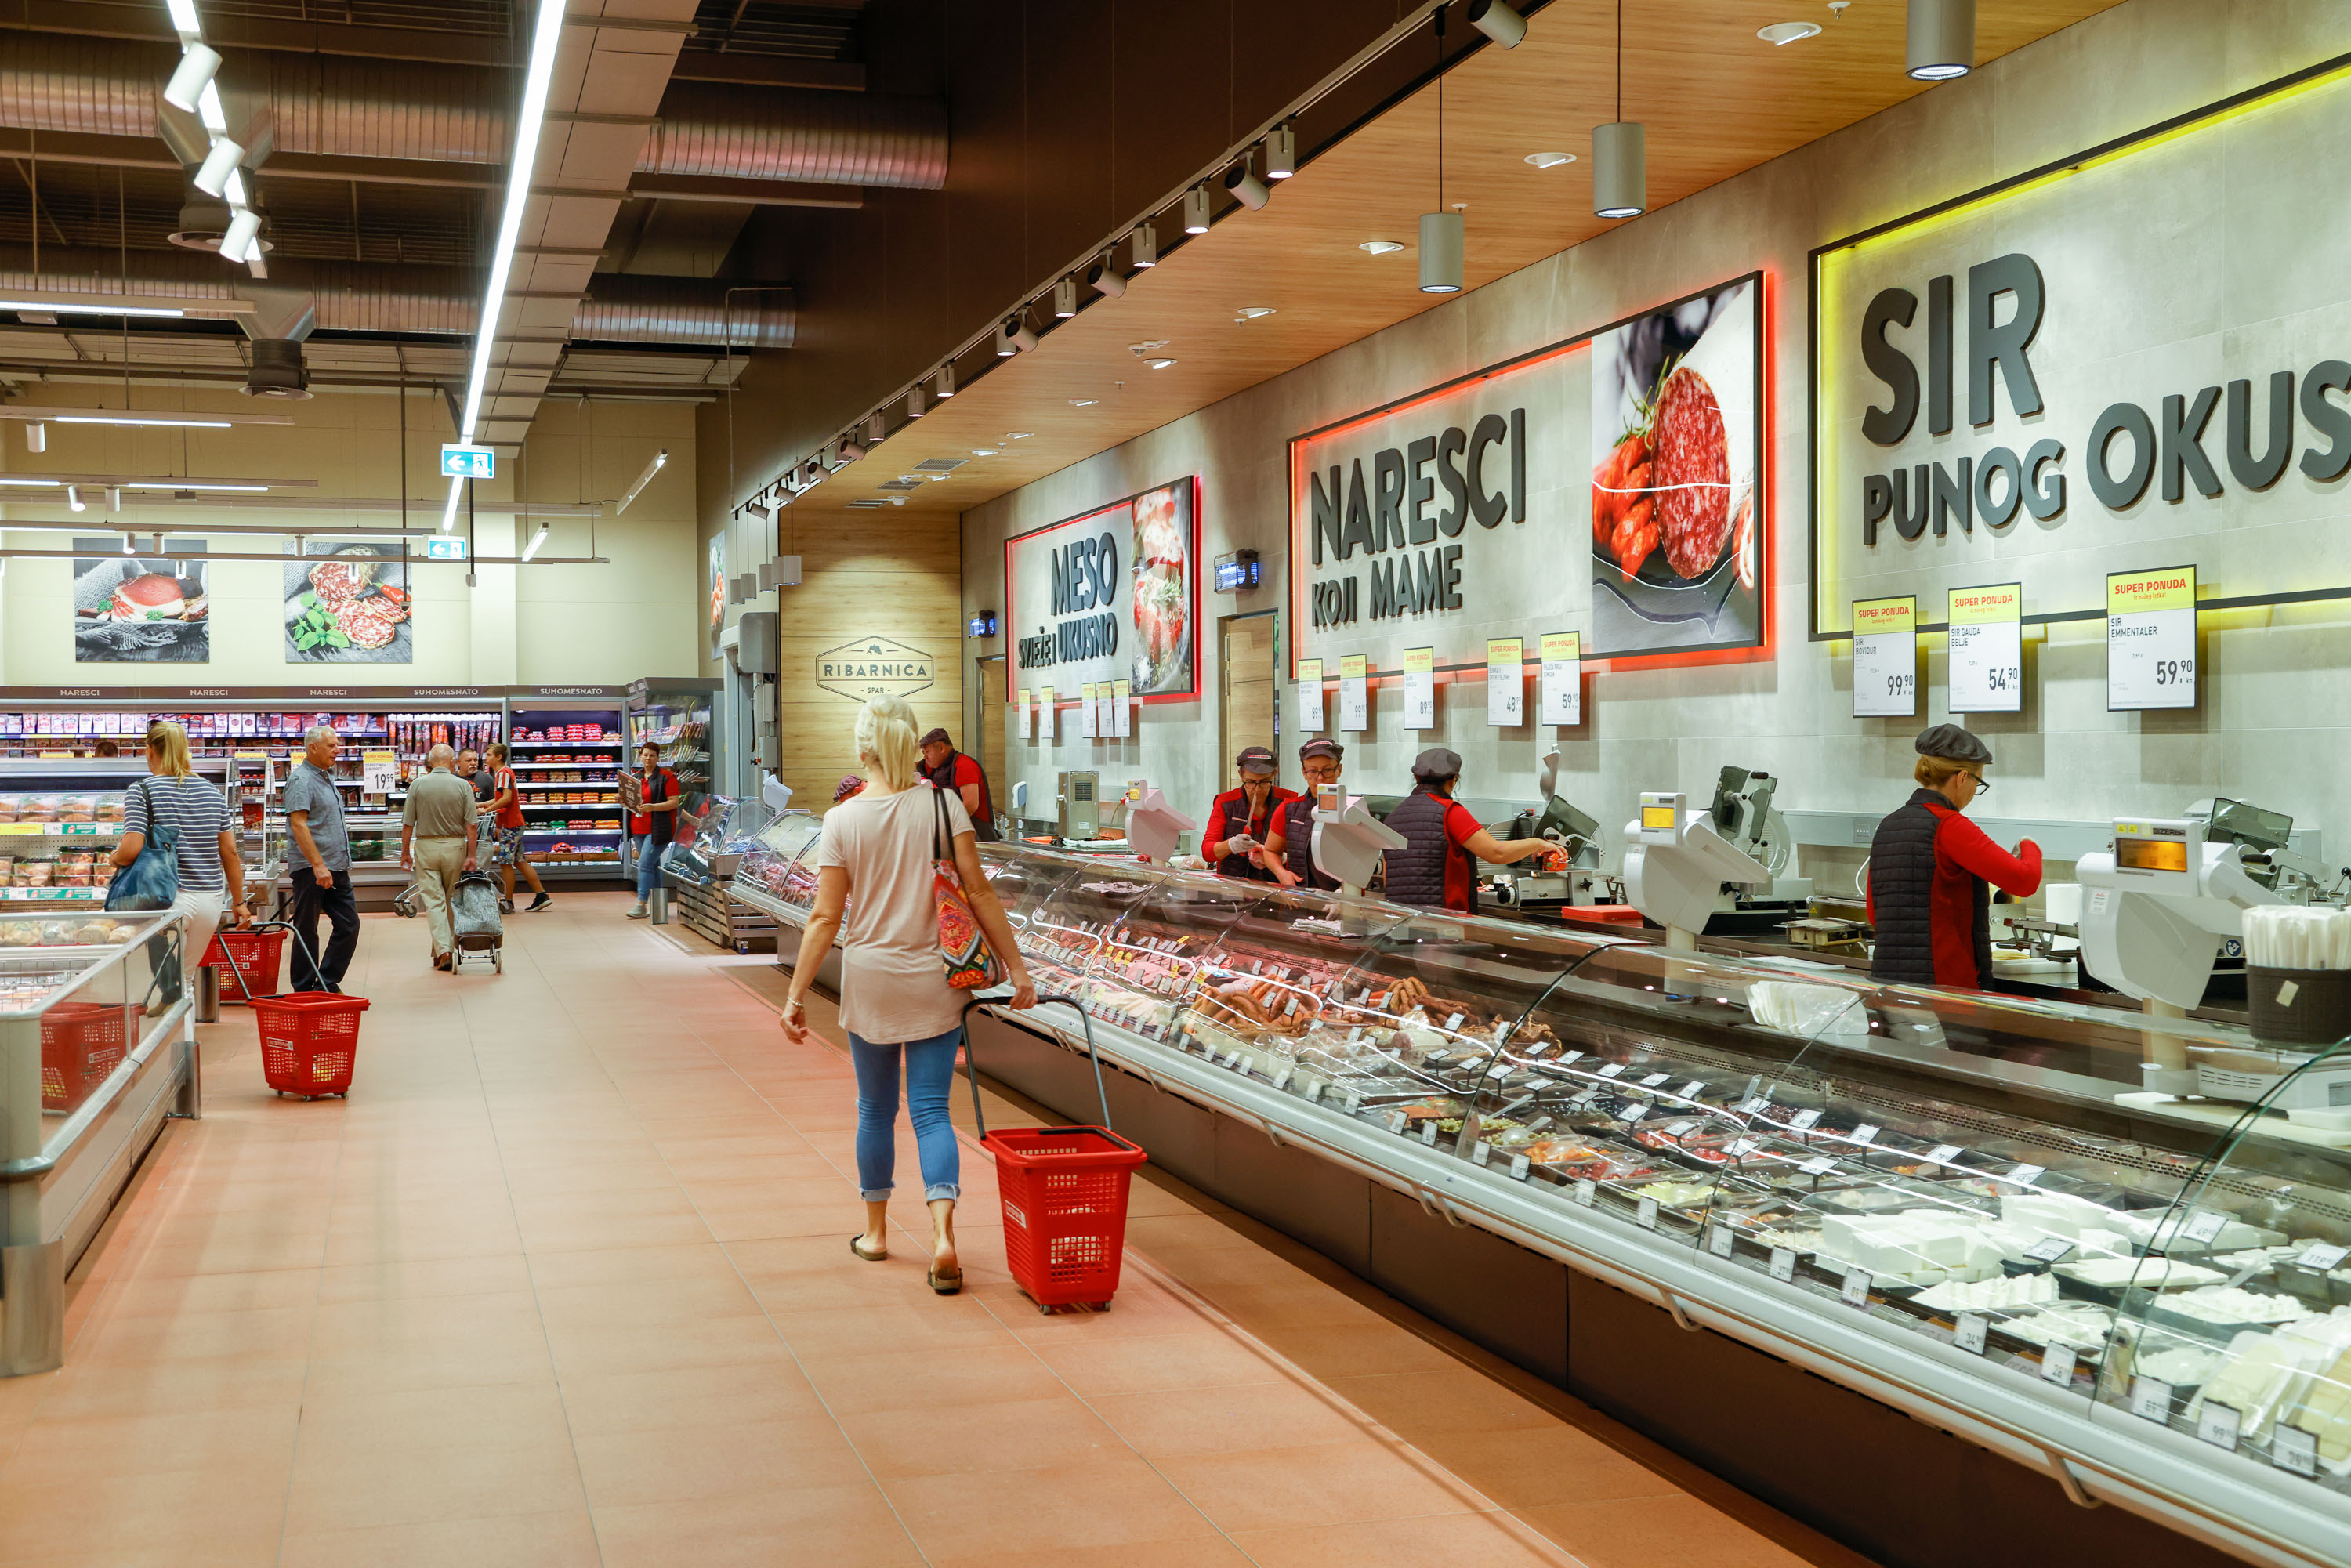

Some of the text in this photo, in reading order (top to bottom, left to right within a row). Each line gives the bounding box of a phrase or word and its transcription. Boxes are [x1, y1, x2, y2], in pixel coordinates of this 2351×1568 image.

[1861, 253, 2045, 445] SIR
[1863, 360, 2351, 545] PUNOG OKUS
[1311, 408, 1526, 567] NARESCI
[1051, 532, 1118, 616] MESO
[1312, 545, 1463, 629] KOJI MAME
[2115, 578, 2186, 595] SUPER PONUDA
[1954, 594, 2013, 607] SUPER PONUDA
[1858, 606, 1910, 618] SUPER PONUDA
[2110, 617, 2122, 627] SIR
[1058, 612, 1118, 663] UKUSNO
[1962, 627, 1980, 636] GAUDA
[2110, 626, 2157, 638] EMMENTALER
[1951, 638, 1969, 646] BELJE
[824, 664, 927, 677] RIBARNICA
[2157, 659, 2193, 685] 59 90
[1887, 675, 1913, 696] 99 90
[1989, 668, 2018, 690] 54 90
[1506, 697, 1516, 712] 48
[1563, 693, 1572, 709] 59
[375, 773, 393, 789] 19 99
